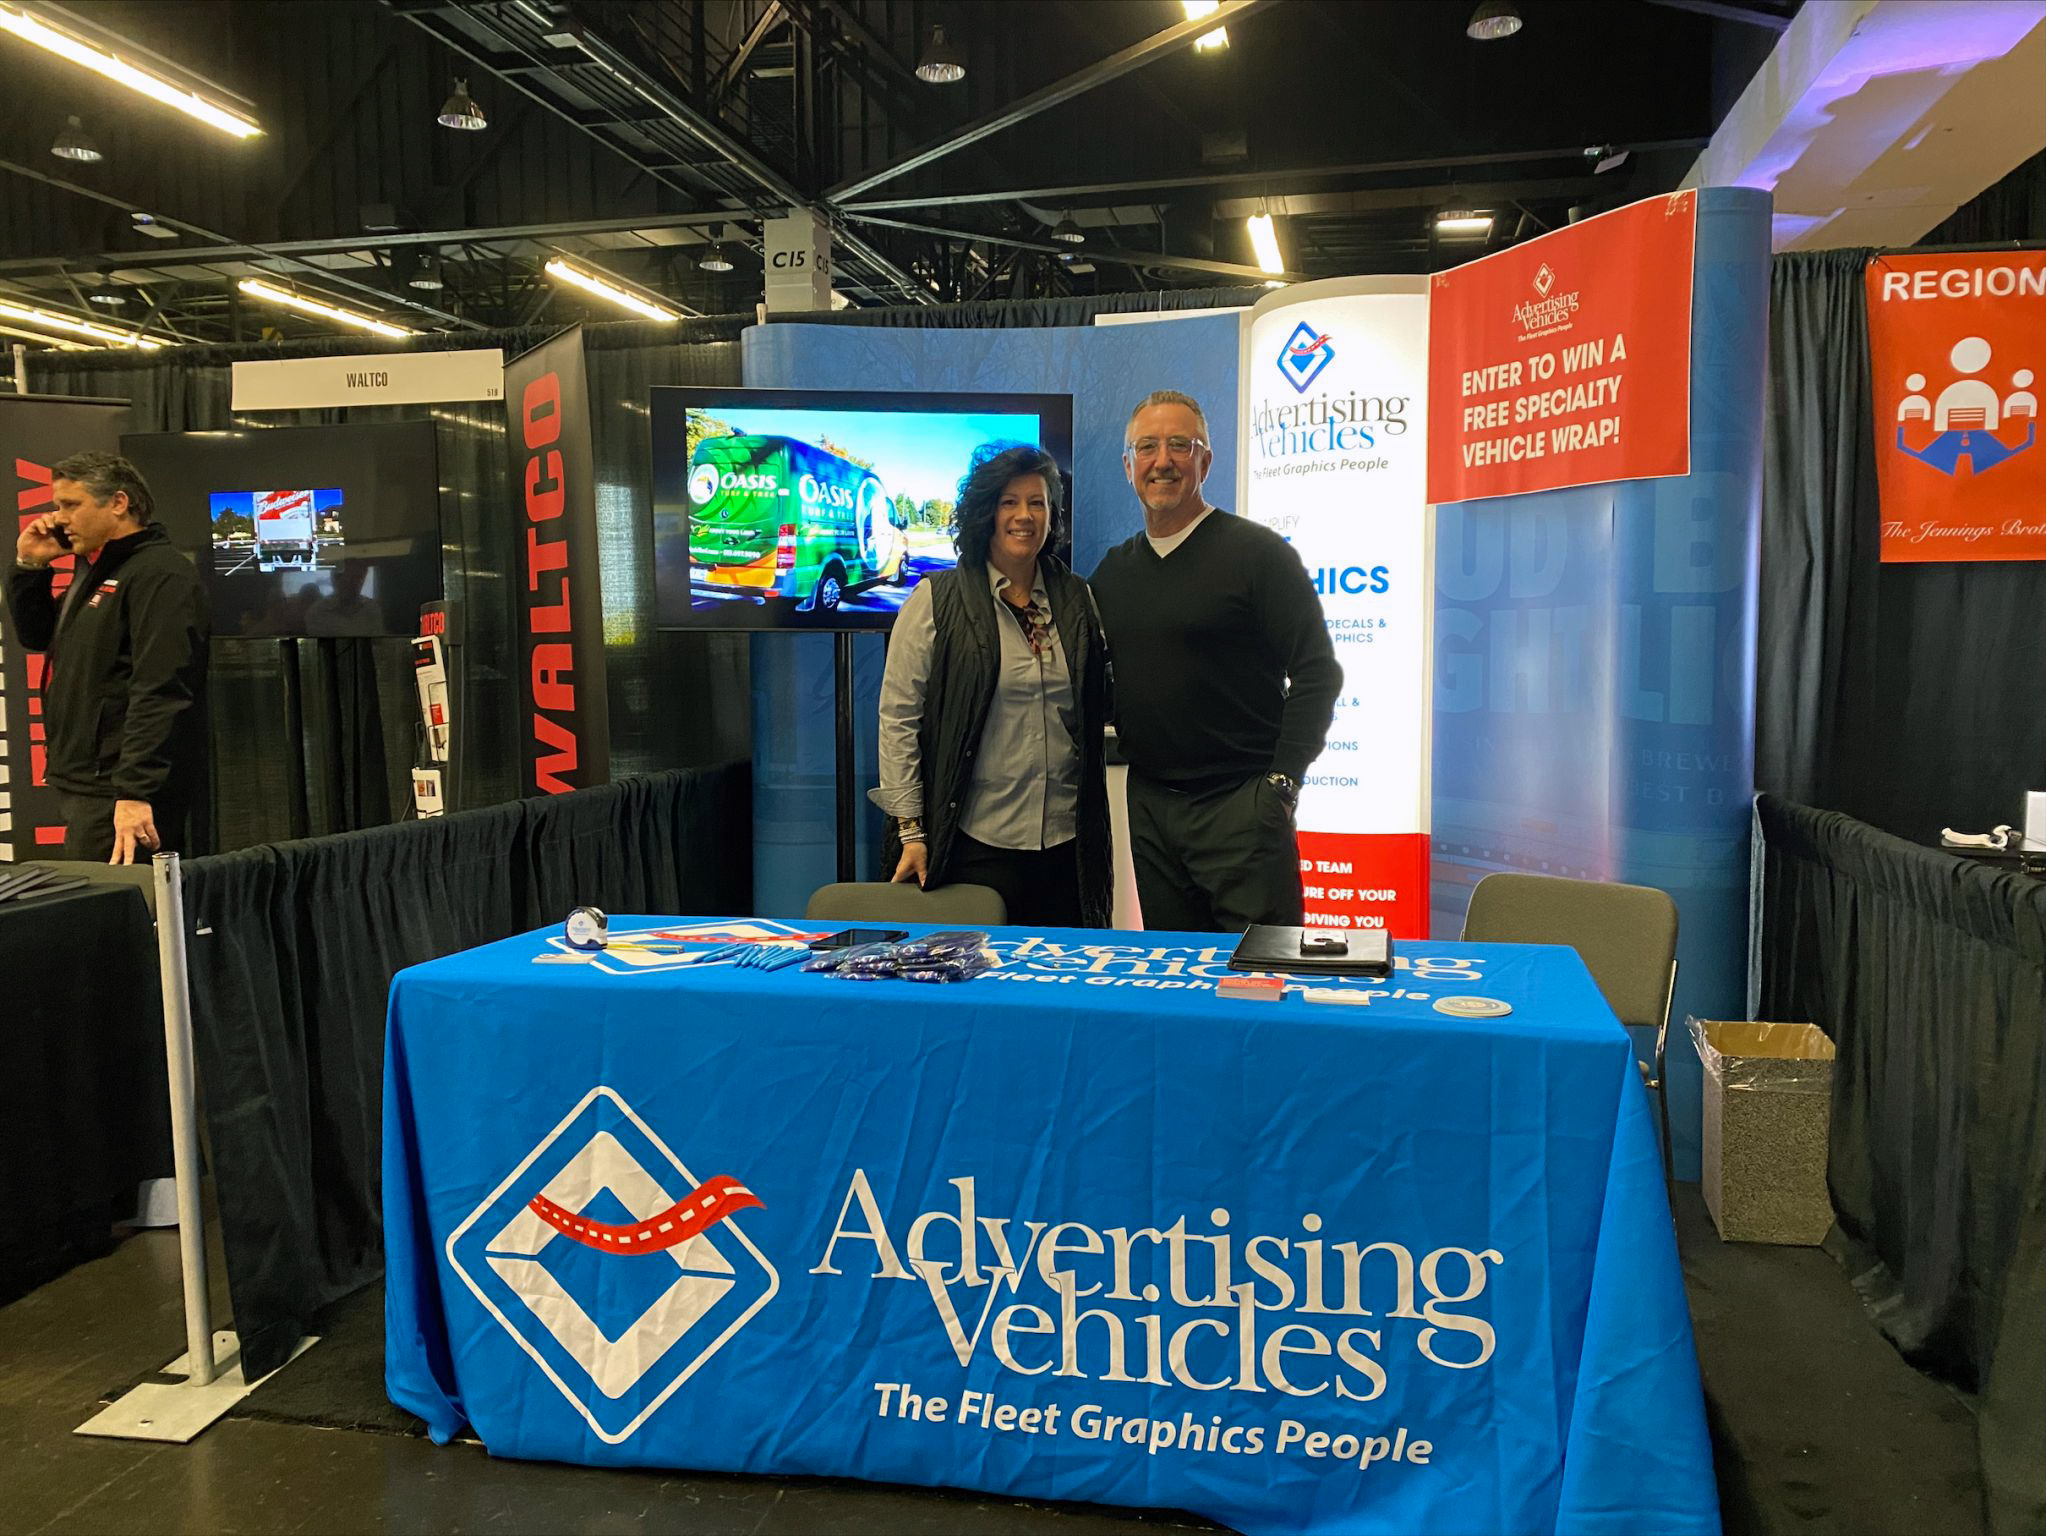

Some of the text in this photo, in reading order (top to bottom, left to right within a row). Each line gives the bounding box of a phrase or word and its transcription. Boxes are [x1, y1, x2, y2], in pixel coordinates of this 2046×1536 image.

[772, 250, 805, 268] C15
[816, 255, 829, 275] C15
[1883, 267, 2046, 302] REGION
[1511, 290, 1580, 323] Advertising
[1522, 306, 1570, 332] Vehicles
[1461, 333, 1627, 398] ENTER TO WIN A
[346, 372, 388, 388] WALTCO
[1251, 391, 1410, 436] Advertising
[1463, 374, 1623, 433] FREE SPECIALTY
[1259, 416, 1375, 458] Vehicles
[1462, 416, 1621, 469] VEHICLE WRAP!
[1262, 465, 1281, 478] Fleet
[1283, 459, 1336, 476] Graphics
[1340, 457, 1389, 473] People
[720, 472, 777, 490] OASIS
[799, 474, 854, 509] OASIS
[1884, 520, 1911, 538] The
[1910, 520, 1994, 544] Jennings
[523, 371, 578, 796] WALTCO
[1379, 618, 1387, 629] &
[1352, 698, 1360, 707] &
[1316, 861, 1353, 874] TEAM
[1328, 889, 1354, 900] OFF
[1358, 889, 1396, 902] YOUR
[1354, 916, 1384, 928] YOU
[975, 971, 1077, 984] Fleet
[808, 1168, 1504, 1369] Advertising
[908, 1257, 1388, 1402] Vehicles
[874, 1382, 1433, 1470] The Fleet Graphics People
